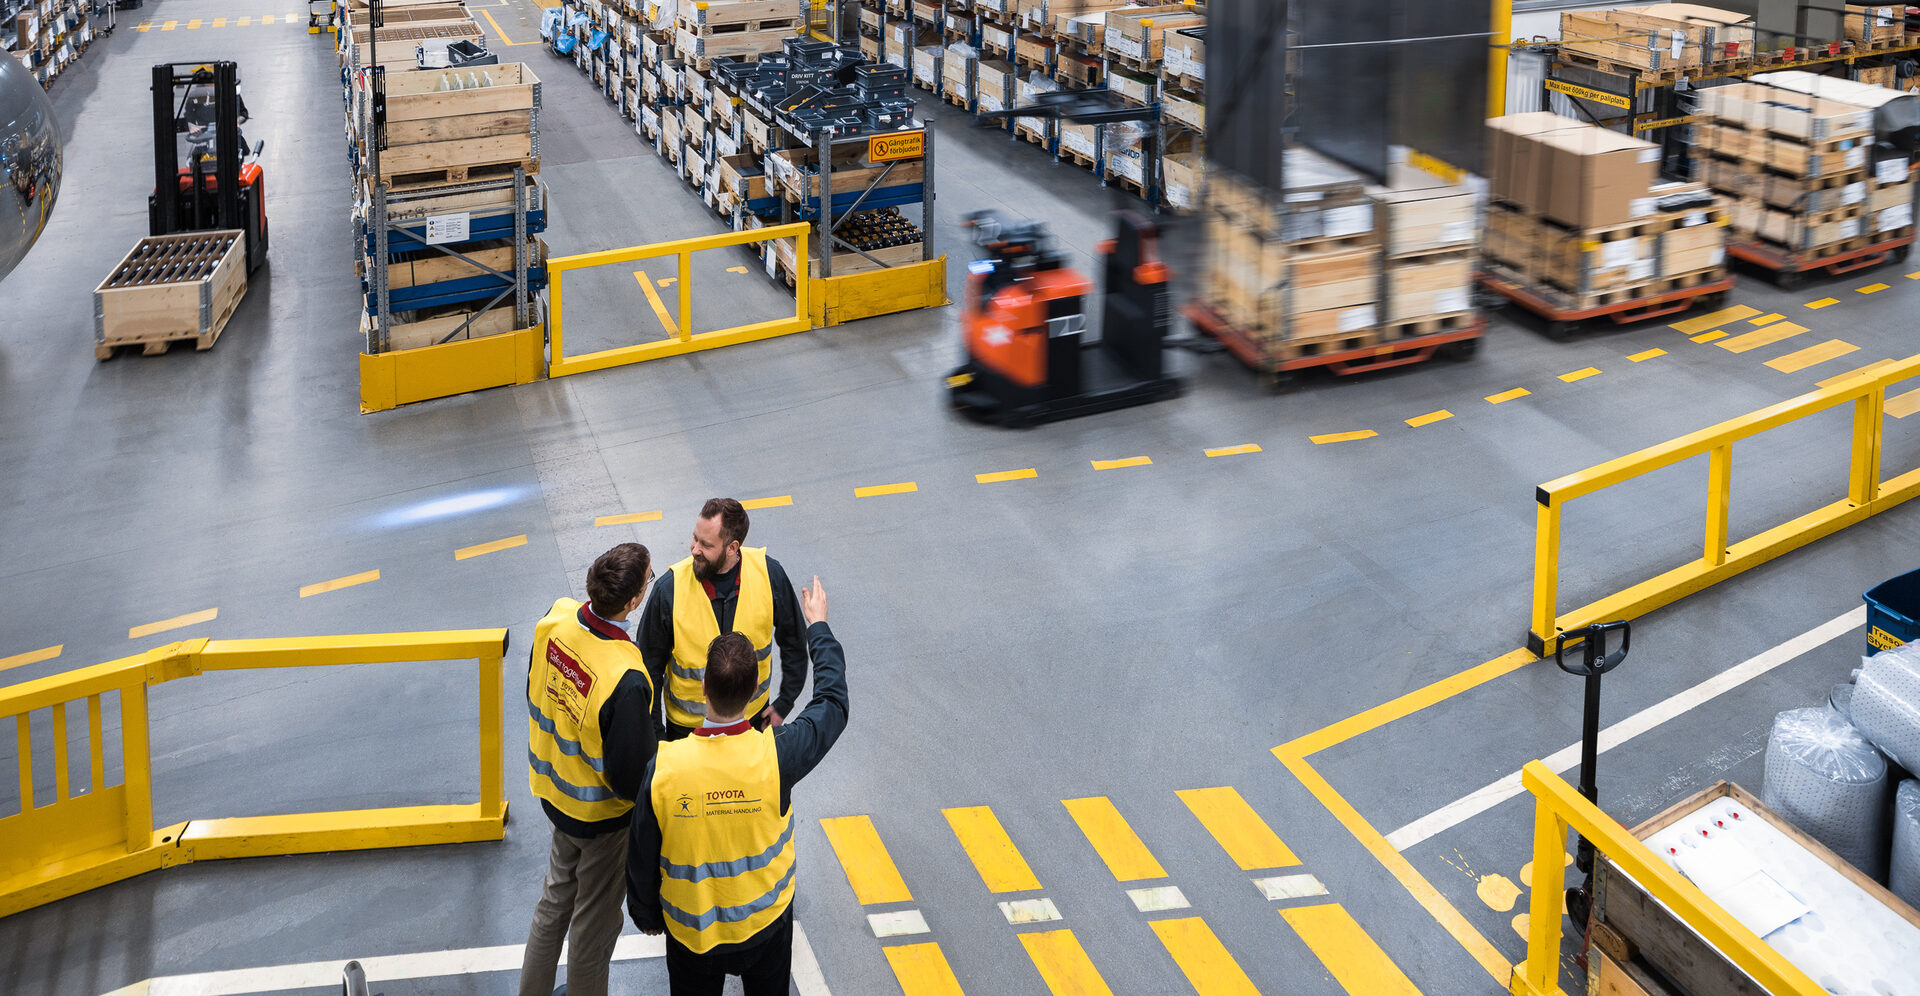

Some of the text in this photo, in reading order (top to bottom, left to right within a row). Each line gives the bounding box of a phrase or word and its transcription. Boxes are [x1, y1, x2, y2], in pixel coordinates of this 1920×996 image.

[1549, 81, 1625, 106] Max last 600kg per pallplats
[889, 137, 921, 147] Gångtrafik
[890, 145, 920, 154] förbjuden
[1873, 628, 1902, 646] Traso
[550, 653, 562, 667] safer
[562, 664, 585, 688] together
[561, 682, 577, 698] TOYOTA
[706, 790, 745, 800] TOYOTA
[706, 809, 733, 817] MATERIAL
[734, 806, 762, 815] HANDLING
